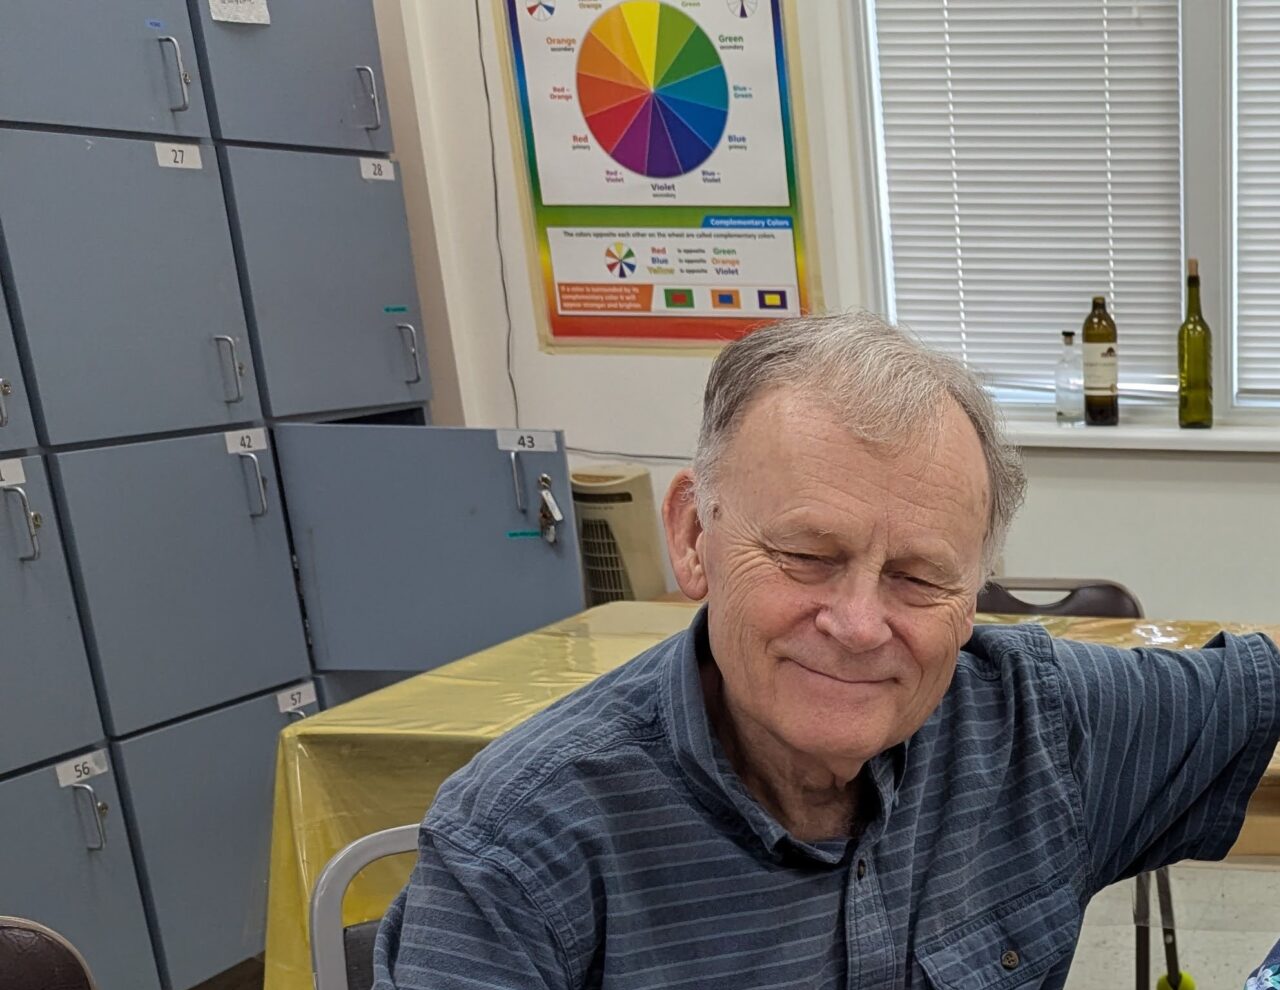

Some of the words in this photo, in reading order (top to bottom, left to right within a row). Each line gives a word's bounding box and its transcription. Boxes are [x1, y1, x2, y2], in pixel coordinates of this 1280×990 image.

[545, 36, 576, 46] Orange
[718, 34, 744, 43] Green
[572, 135, 589, 143] Red
[728, 134, 747, 143] Blue
[171, 148, 184, 164] 27
[372, 162, 383, 176] 28
[710, 218, 765, 227] Complementary
[766, 218, 789, 226] Colors
[651, 246, 666, 254] Red
[712, 247, 736, 255] Green
[651, 256, 668, 264] Blue
[711, 257, 739, 266] Orange
[715, 267, 739, 275] Violet
[240, 435, 253, 448] 42
[517, 435, 535, 449] 43
[290, 691, 302, 706] 57
[74, 761, 90, 778] 56
